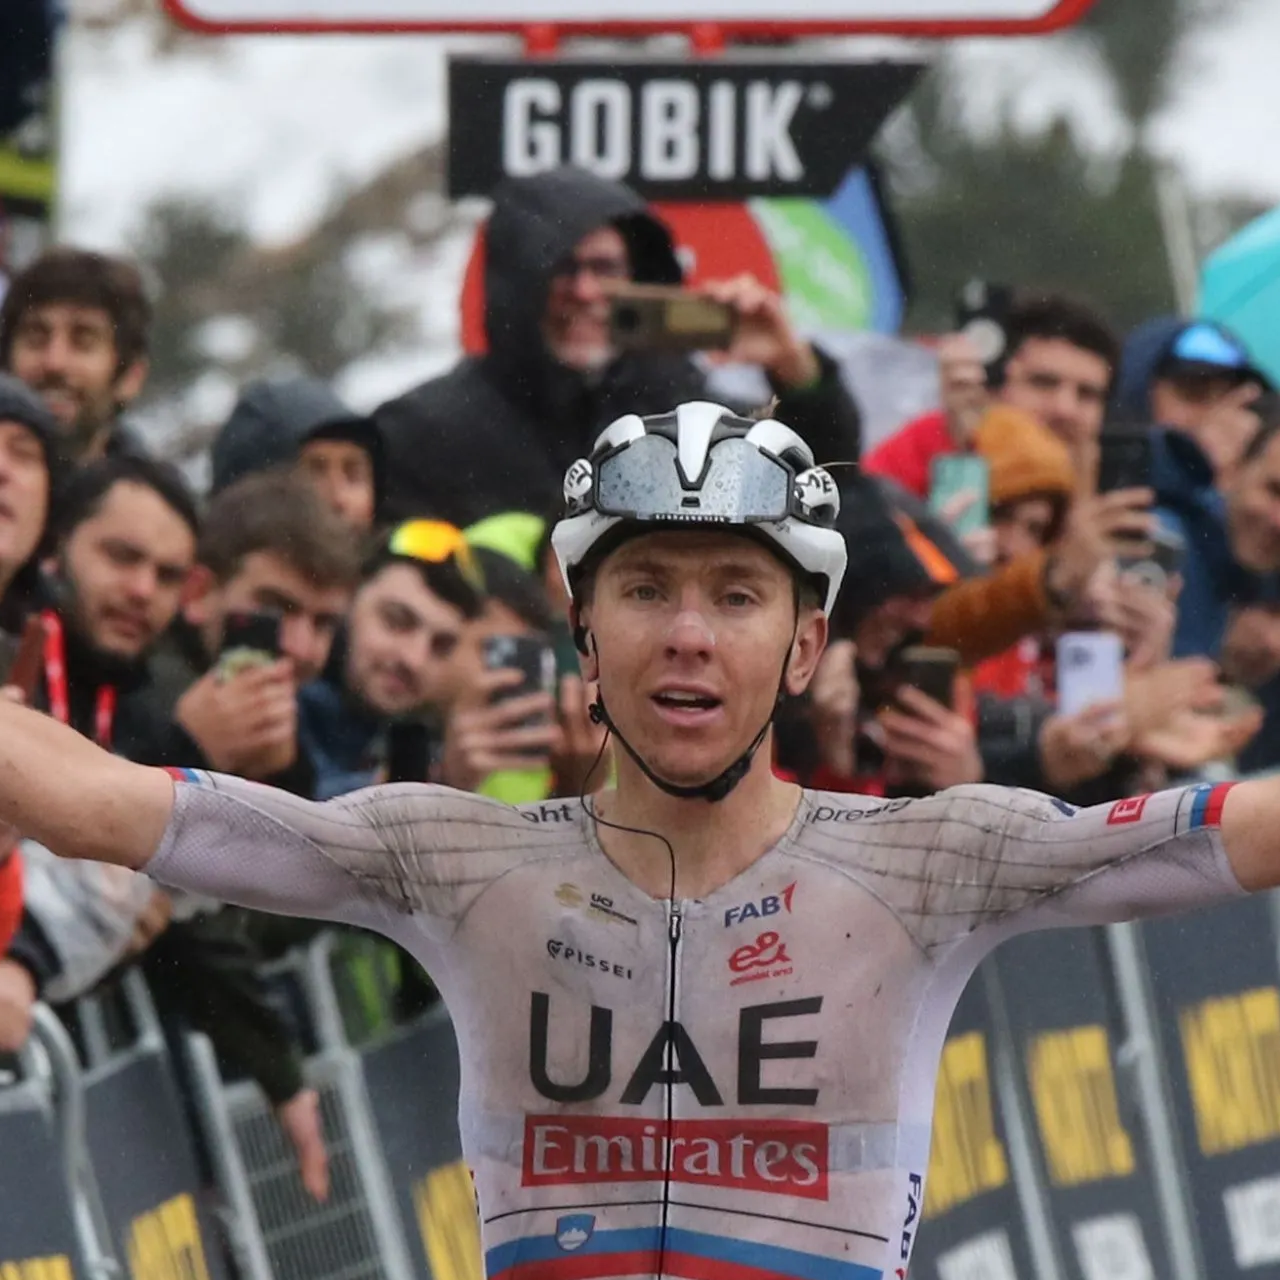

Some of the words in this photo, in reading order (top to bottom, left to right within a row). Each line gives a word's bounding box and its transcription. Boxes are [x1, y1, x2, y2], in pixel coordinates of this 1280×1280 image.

[503, 79, 805, 181] GOBIK
[564, 947, 632, 980] PISSEI
[530, 991, 824, 1107] UAE
[531, 1125, 820, 1187] Emirates
